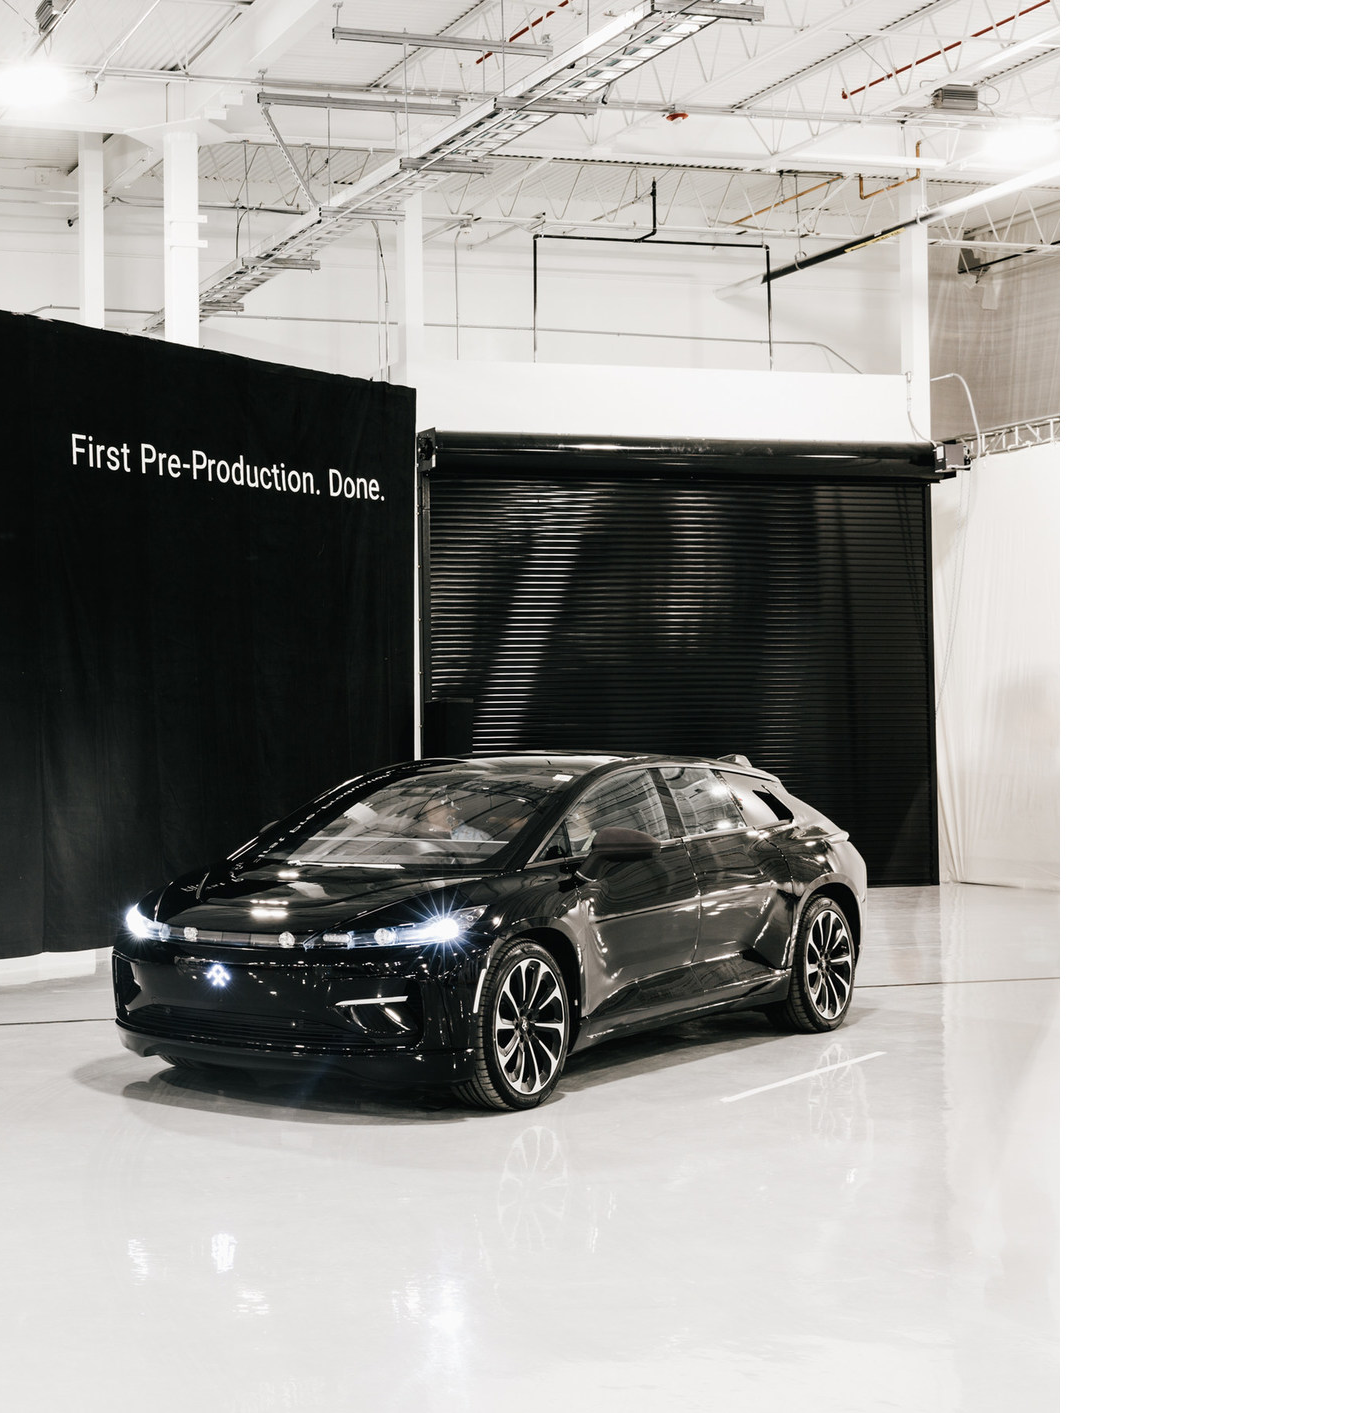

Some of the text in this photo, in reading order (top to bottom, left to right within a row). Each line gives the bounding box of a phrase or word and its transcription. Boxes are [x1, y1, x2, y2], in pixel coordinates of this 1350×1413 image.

[71, 433, 386, 502] First Pre-Production. Done.
